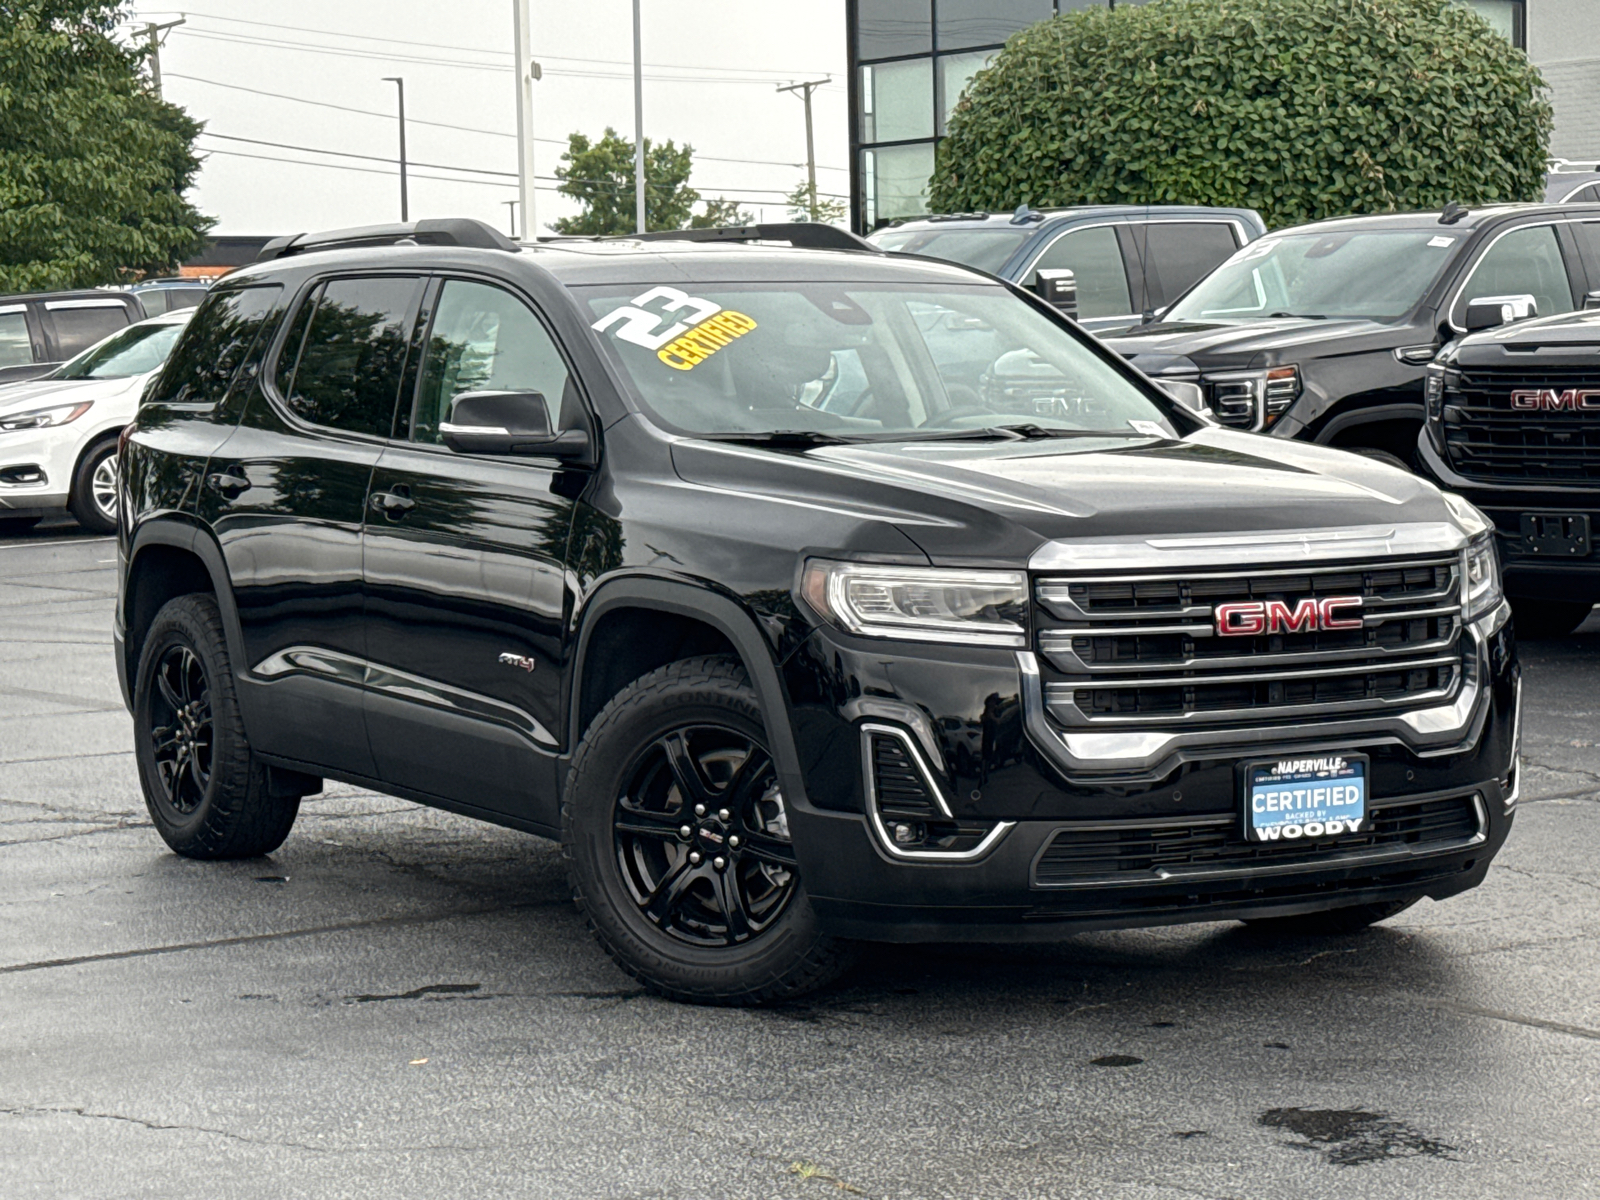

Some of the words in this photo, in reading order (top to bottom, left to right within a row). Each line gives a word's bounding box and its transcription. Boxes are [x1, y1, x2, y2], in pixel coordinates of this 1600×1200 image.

[591, 286, 722, 350] 23
[657, 310, 758, 371] CERTIFIED
[1510, 389, 1600, 412] GMC
[1214, 595, 1364, 637] GMC
[1277, 757, 1342, 774] NAPERVILLE
[1252, 785, 1360, 813] CERTIFIED
[1285, 811, 1315, 820] BACKED
[1316, 810, 1327, 818] BY
[1256, 818, 1364, 841] WOODY
